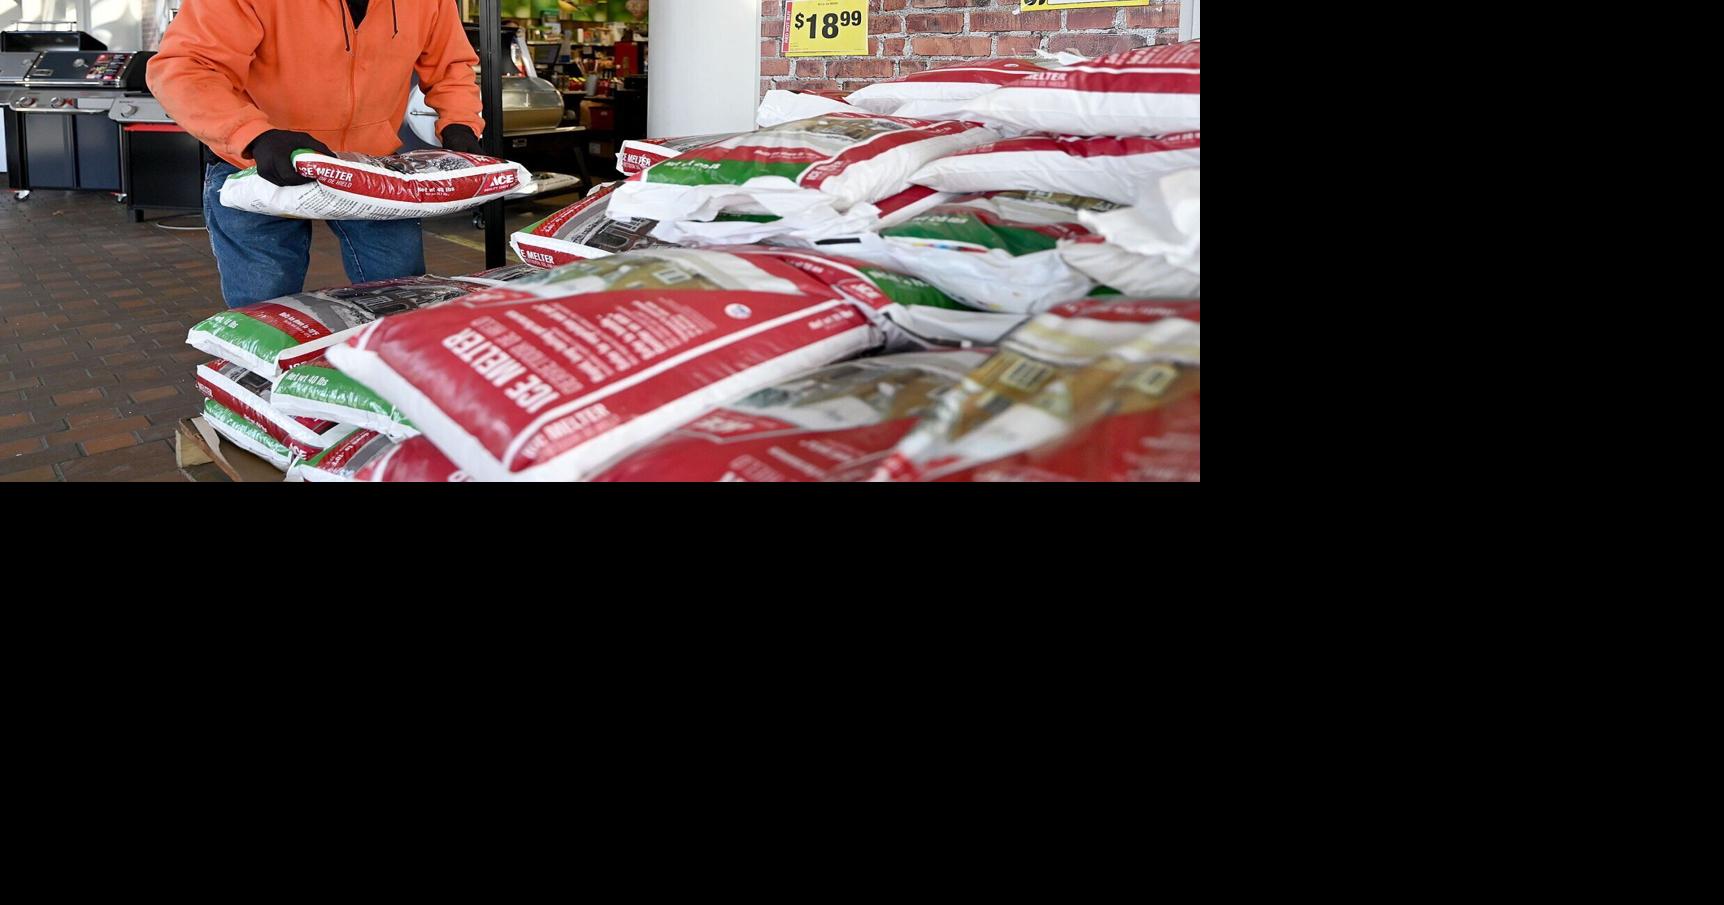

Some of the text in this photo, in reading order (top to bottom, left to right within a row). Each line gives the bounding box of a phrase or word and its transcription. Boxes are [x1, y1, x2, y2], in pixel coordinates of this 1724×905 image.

[316, 167, 353, 182] MELTER
[490, 174, 514, 187] ACE
[526, 250, 555, 265] MELTER
[441, 327, 560, 414] ICE MELTER
